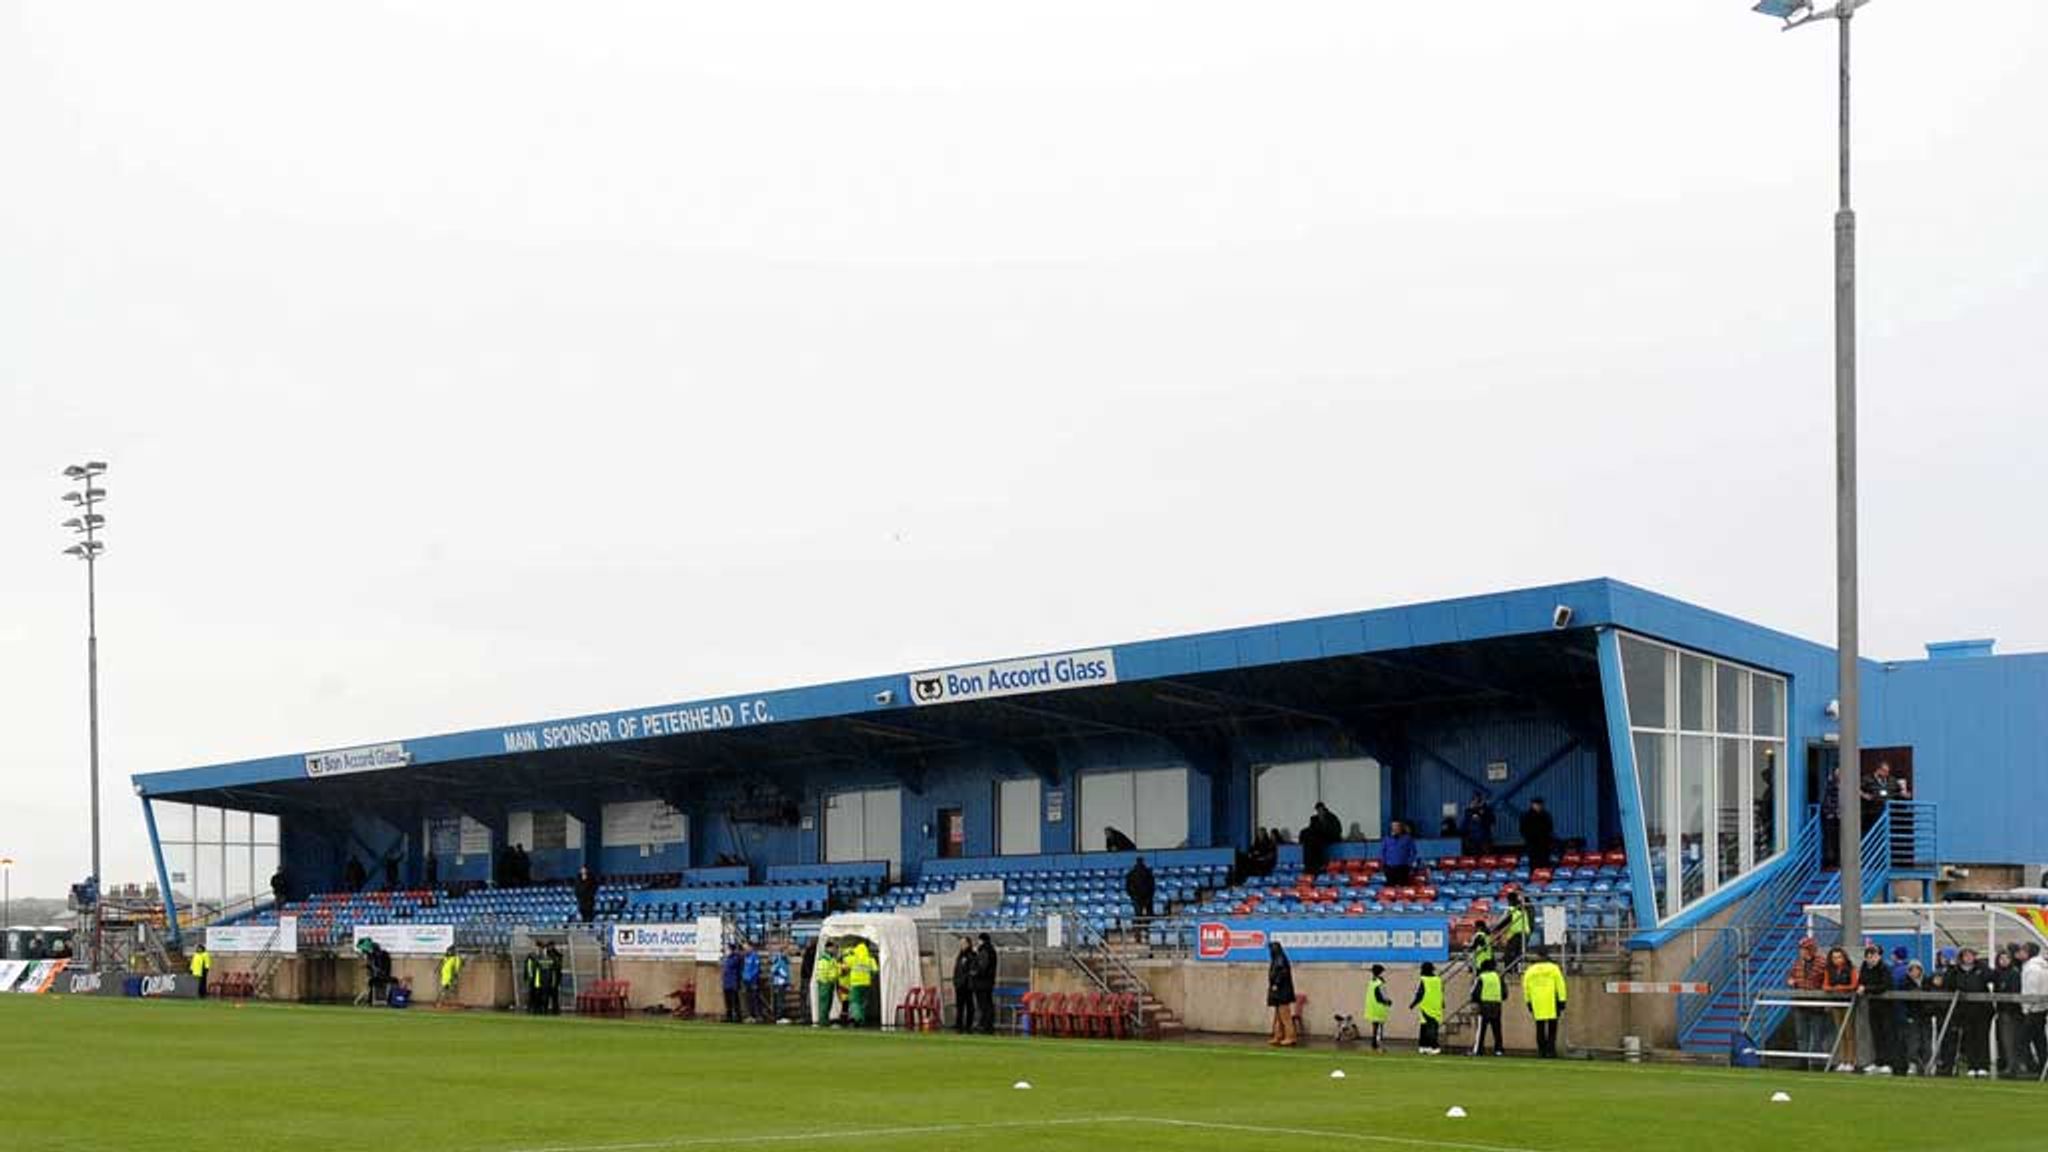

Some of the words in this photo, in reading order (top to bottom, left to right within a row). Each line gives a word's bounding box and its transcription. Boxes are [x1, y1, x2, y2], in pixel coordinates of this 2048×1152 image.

[945, 673, 983, 696] Bon
[988, 661, 1050, 692] Accord
[1055, 657, 1107, 682] Glass
[503, 731, 537, 752] MAIN
[543, 720, 611, 748] SPONSOR
[617, 716, 638, 737] OF
[642, 703, 734, 736] PETERHEAD
[740, 700, 774, 724] F.C.
[323, 755, 343, 772] Bon
[637, 928, 659, 945] Bon
